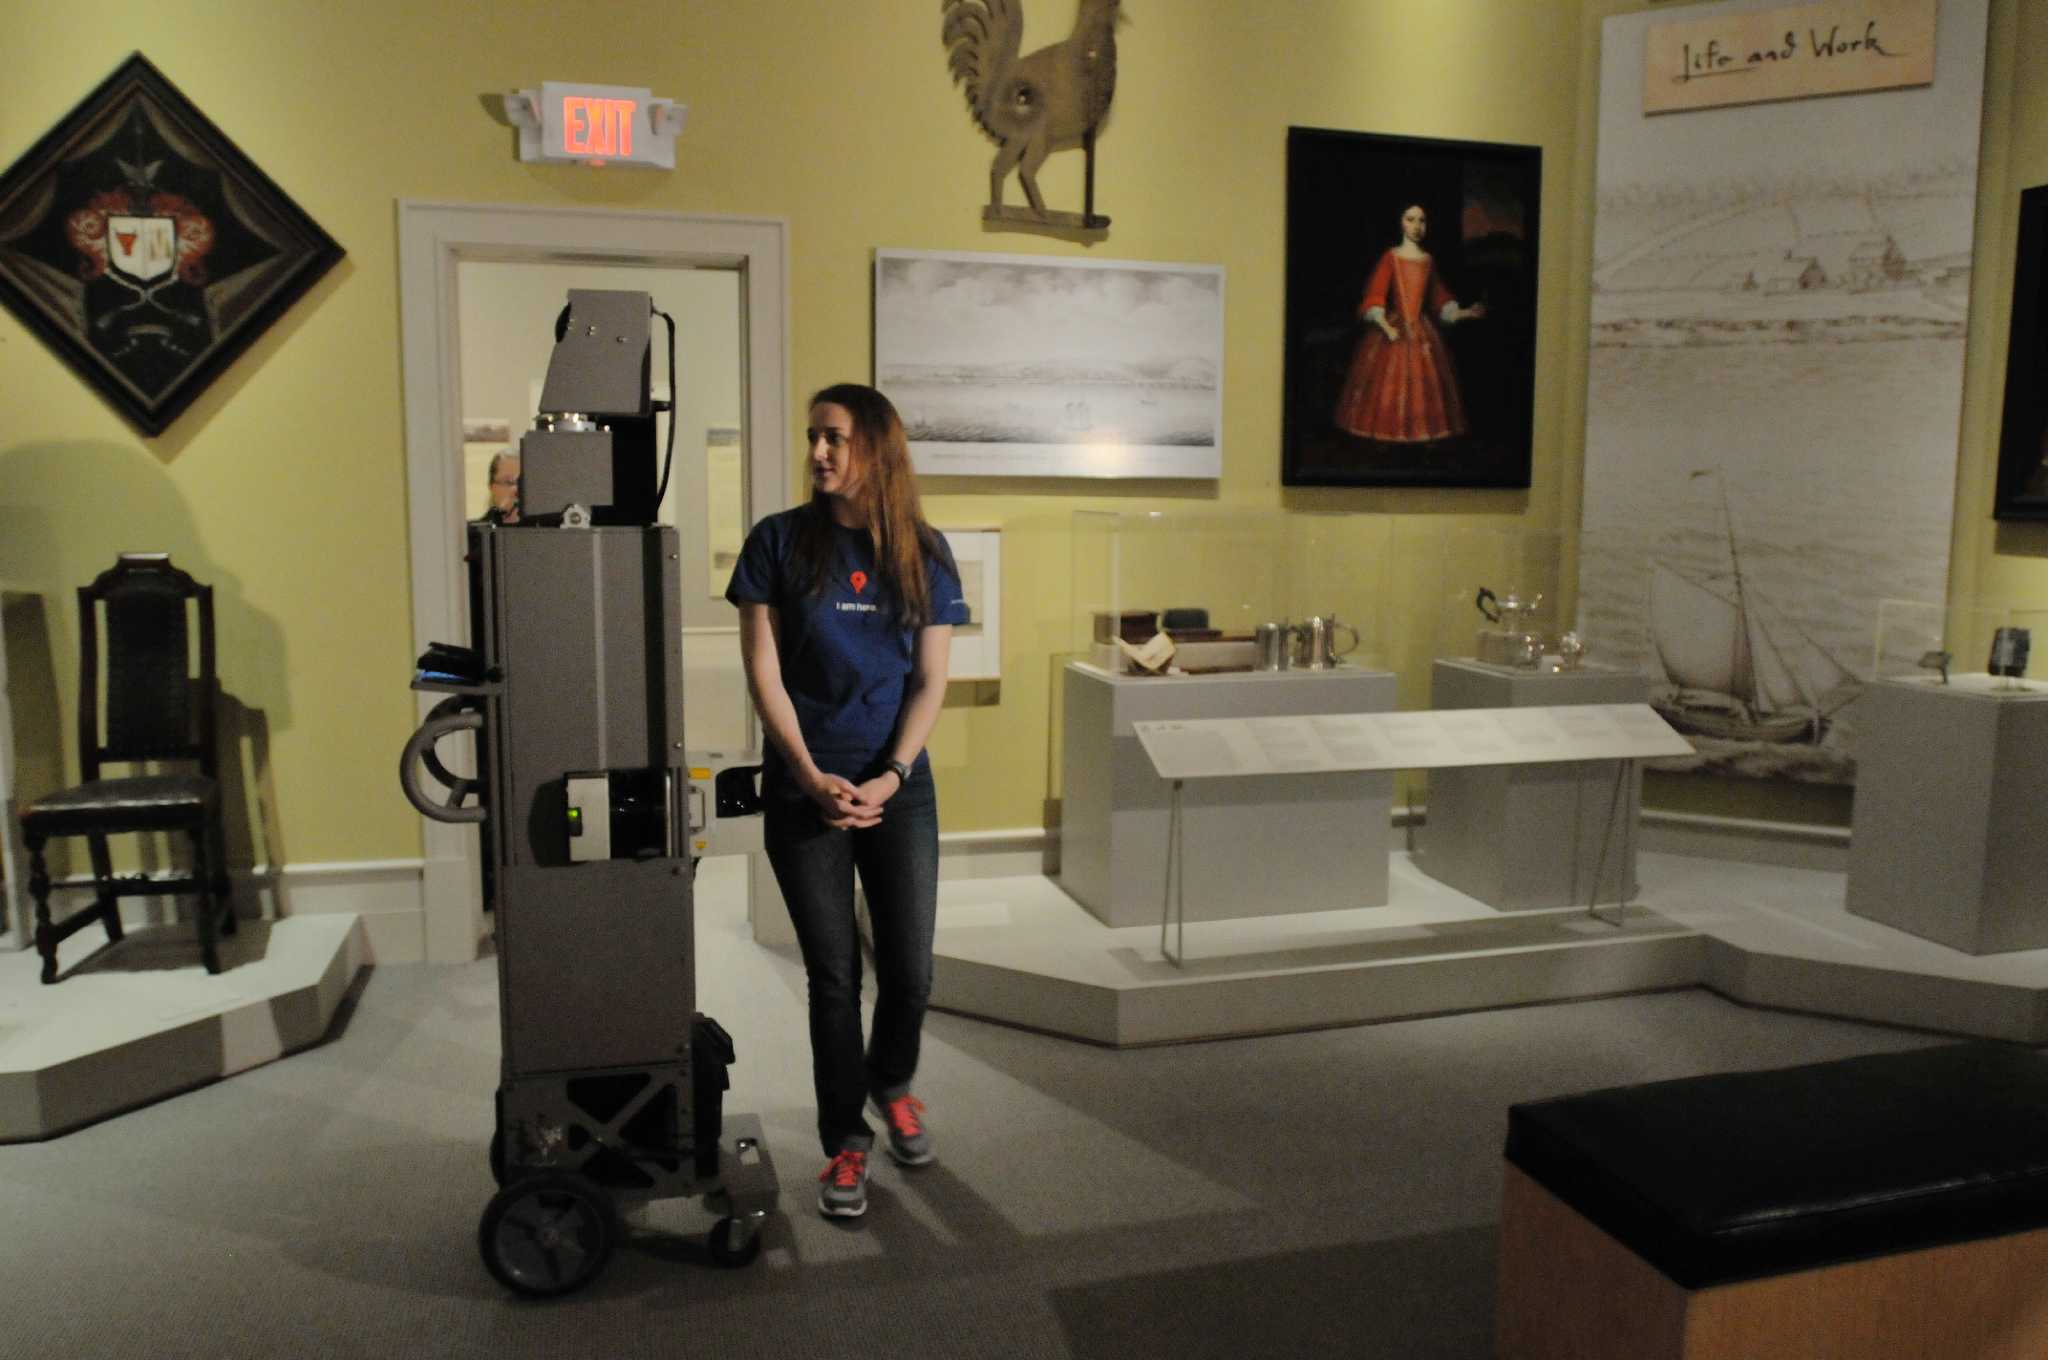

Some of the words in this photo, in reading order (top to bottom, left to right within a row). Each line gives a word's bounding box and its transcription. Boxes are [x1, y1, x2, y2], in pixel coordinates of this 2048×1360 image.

[1675, 41, 1732, 82] Life
[1746, 31, 1797, 66] and
[1809, 21, 1904, 58] Work
[563, 96, 636, 156] EXIT
[841, 602, 857, 611] am
